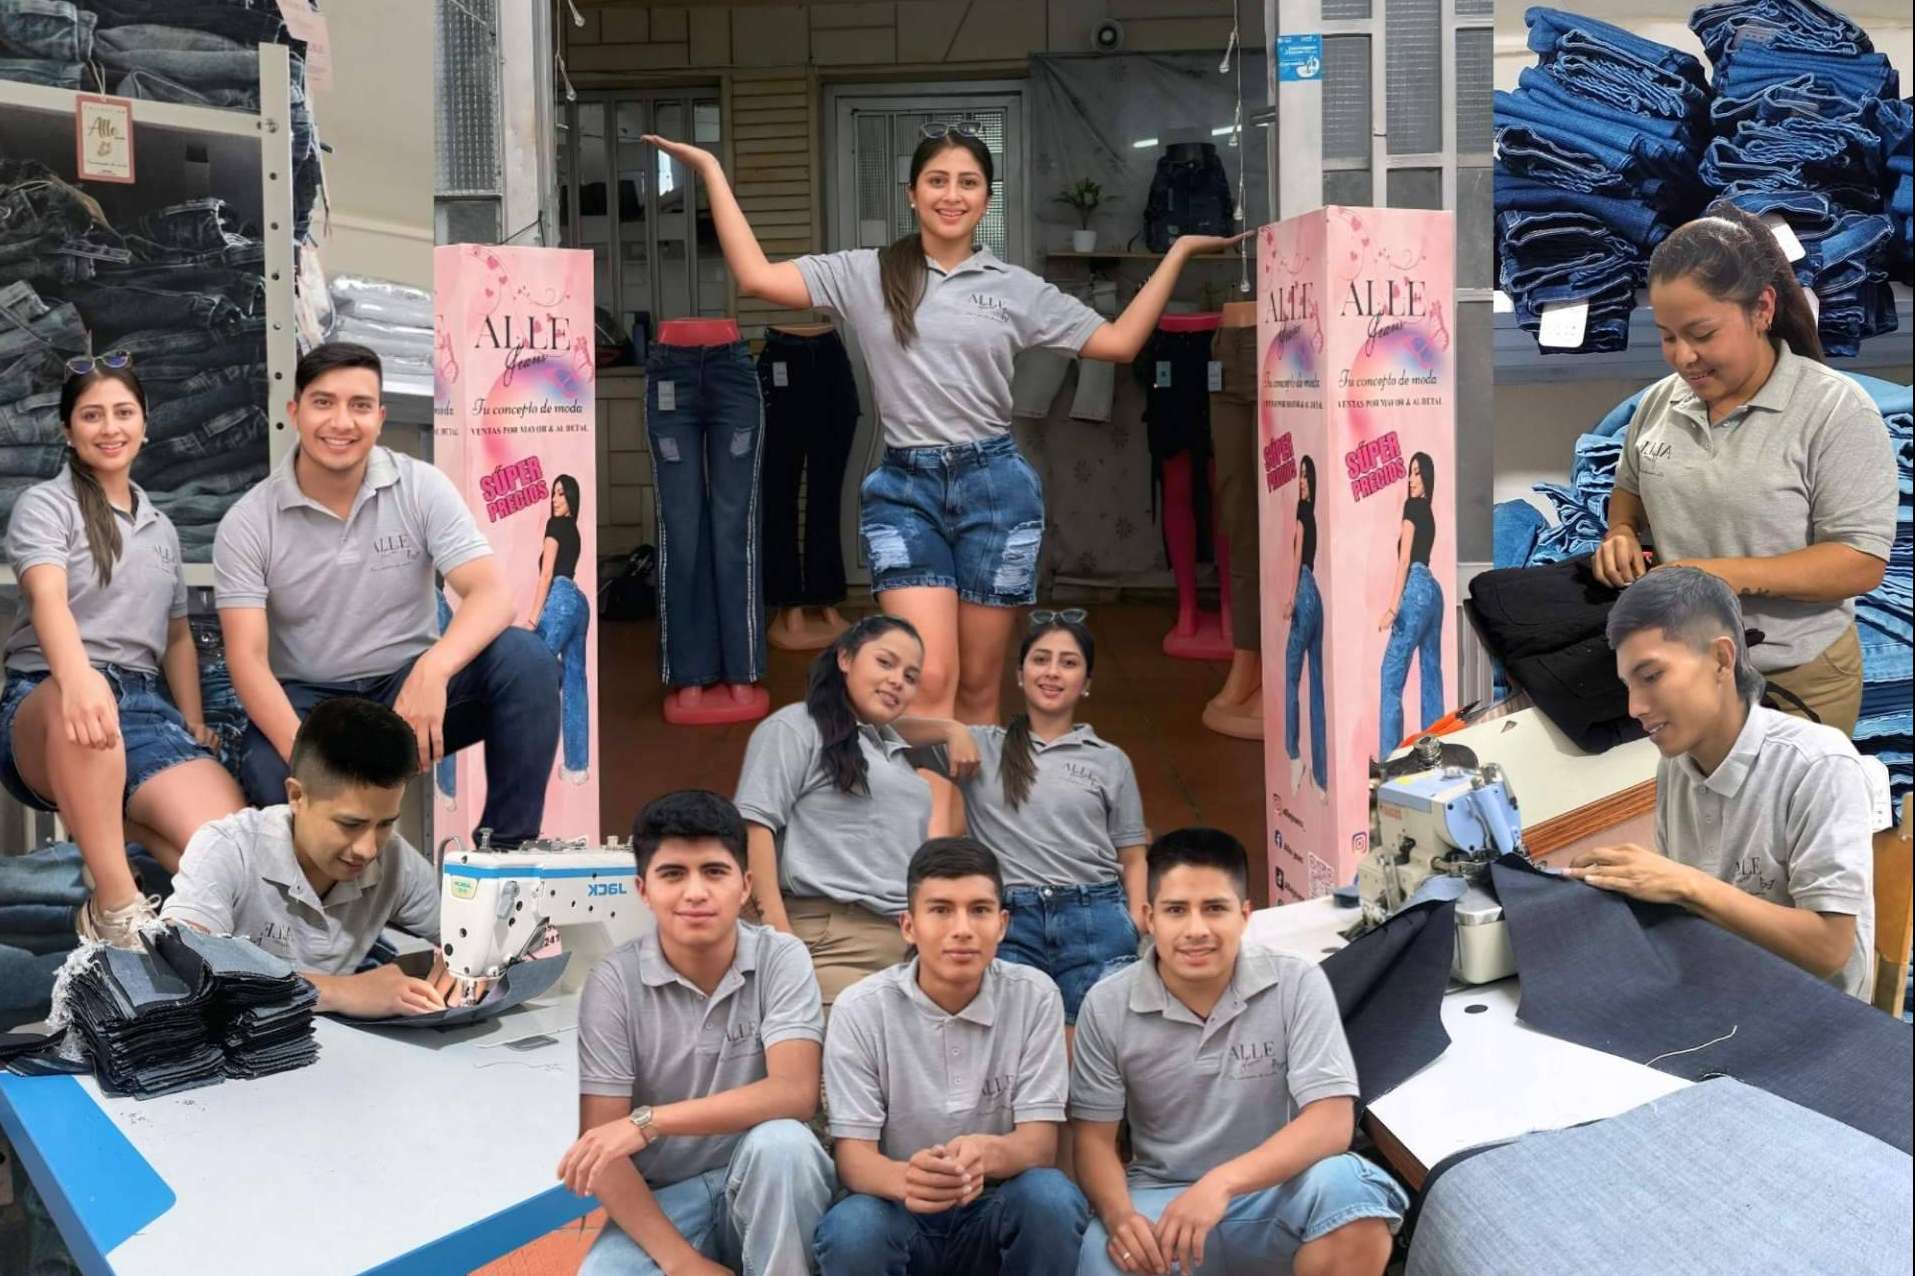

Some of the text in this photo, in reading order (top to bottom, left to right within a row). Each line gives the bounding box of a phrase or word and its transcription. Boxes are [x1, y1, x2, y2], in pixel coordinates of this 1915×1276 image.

[1265, 282, 1313, 323] ALLE
[1339, 280, 1426, 316] ALLE
[474, 314, 571, 350] ALLE
[1338, 368, 1437, 391] Tu concepto de moda
[472, 398, 583, 418] Tu concepto de moda
[471, 427, 501, 436] VENTAS
[1345, 431, 1402, 479] SÚPER
[480, 455, 543, 502] SÚPER
[1350, 457, 1407, 503] PRECIOS
[486, 480, 549, 523] PRECIOS
[1227, 1041, 1275, 1062] ALLE
